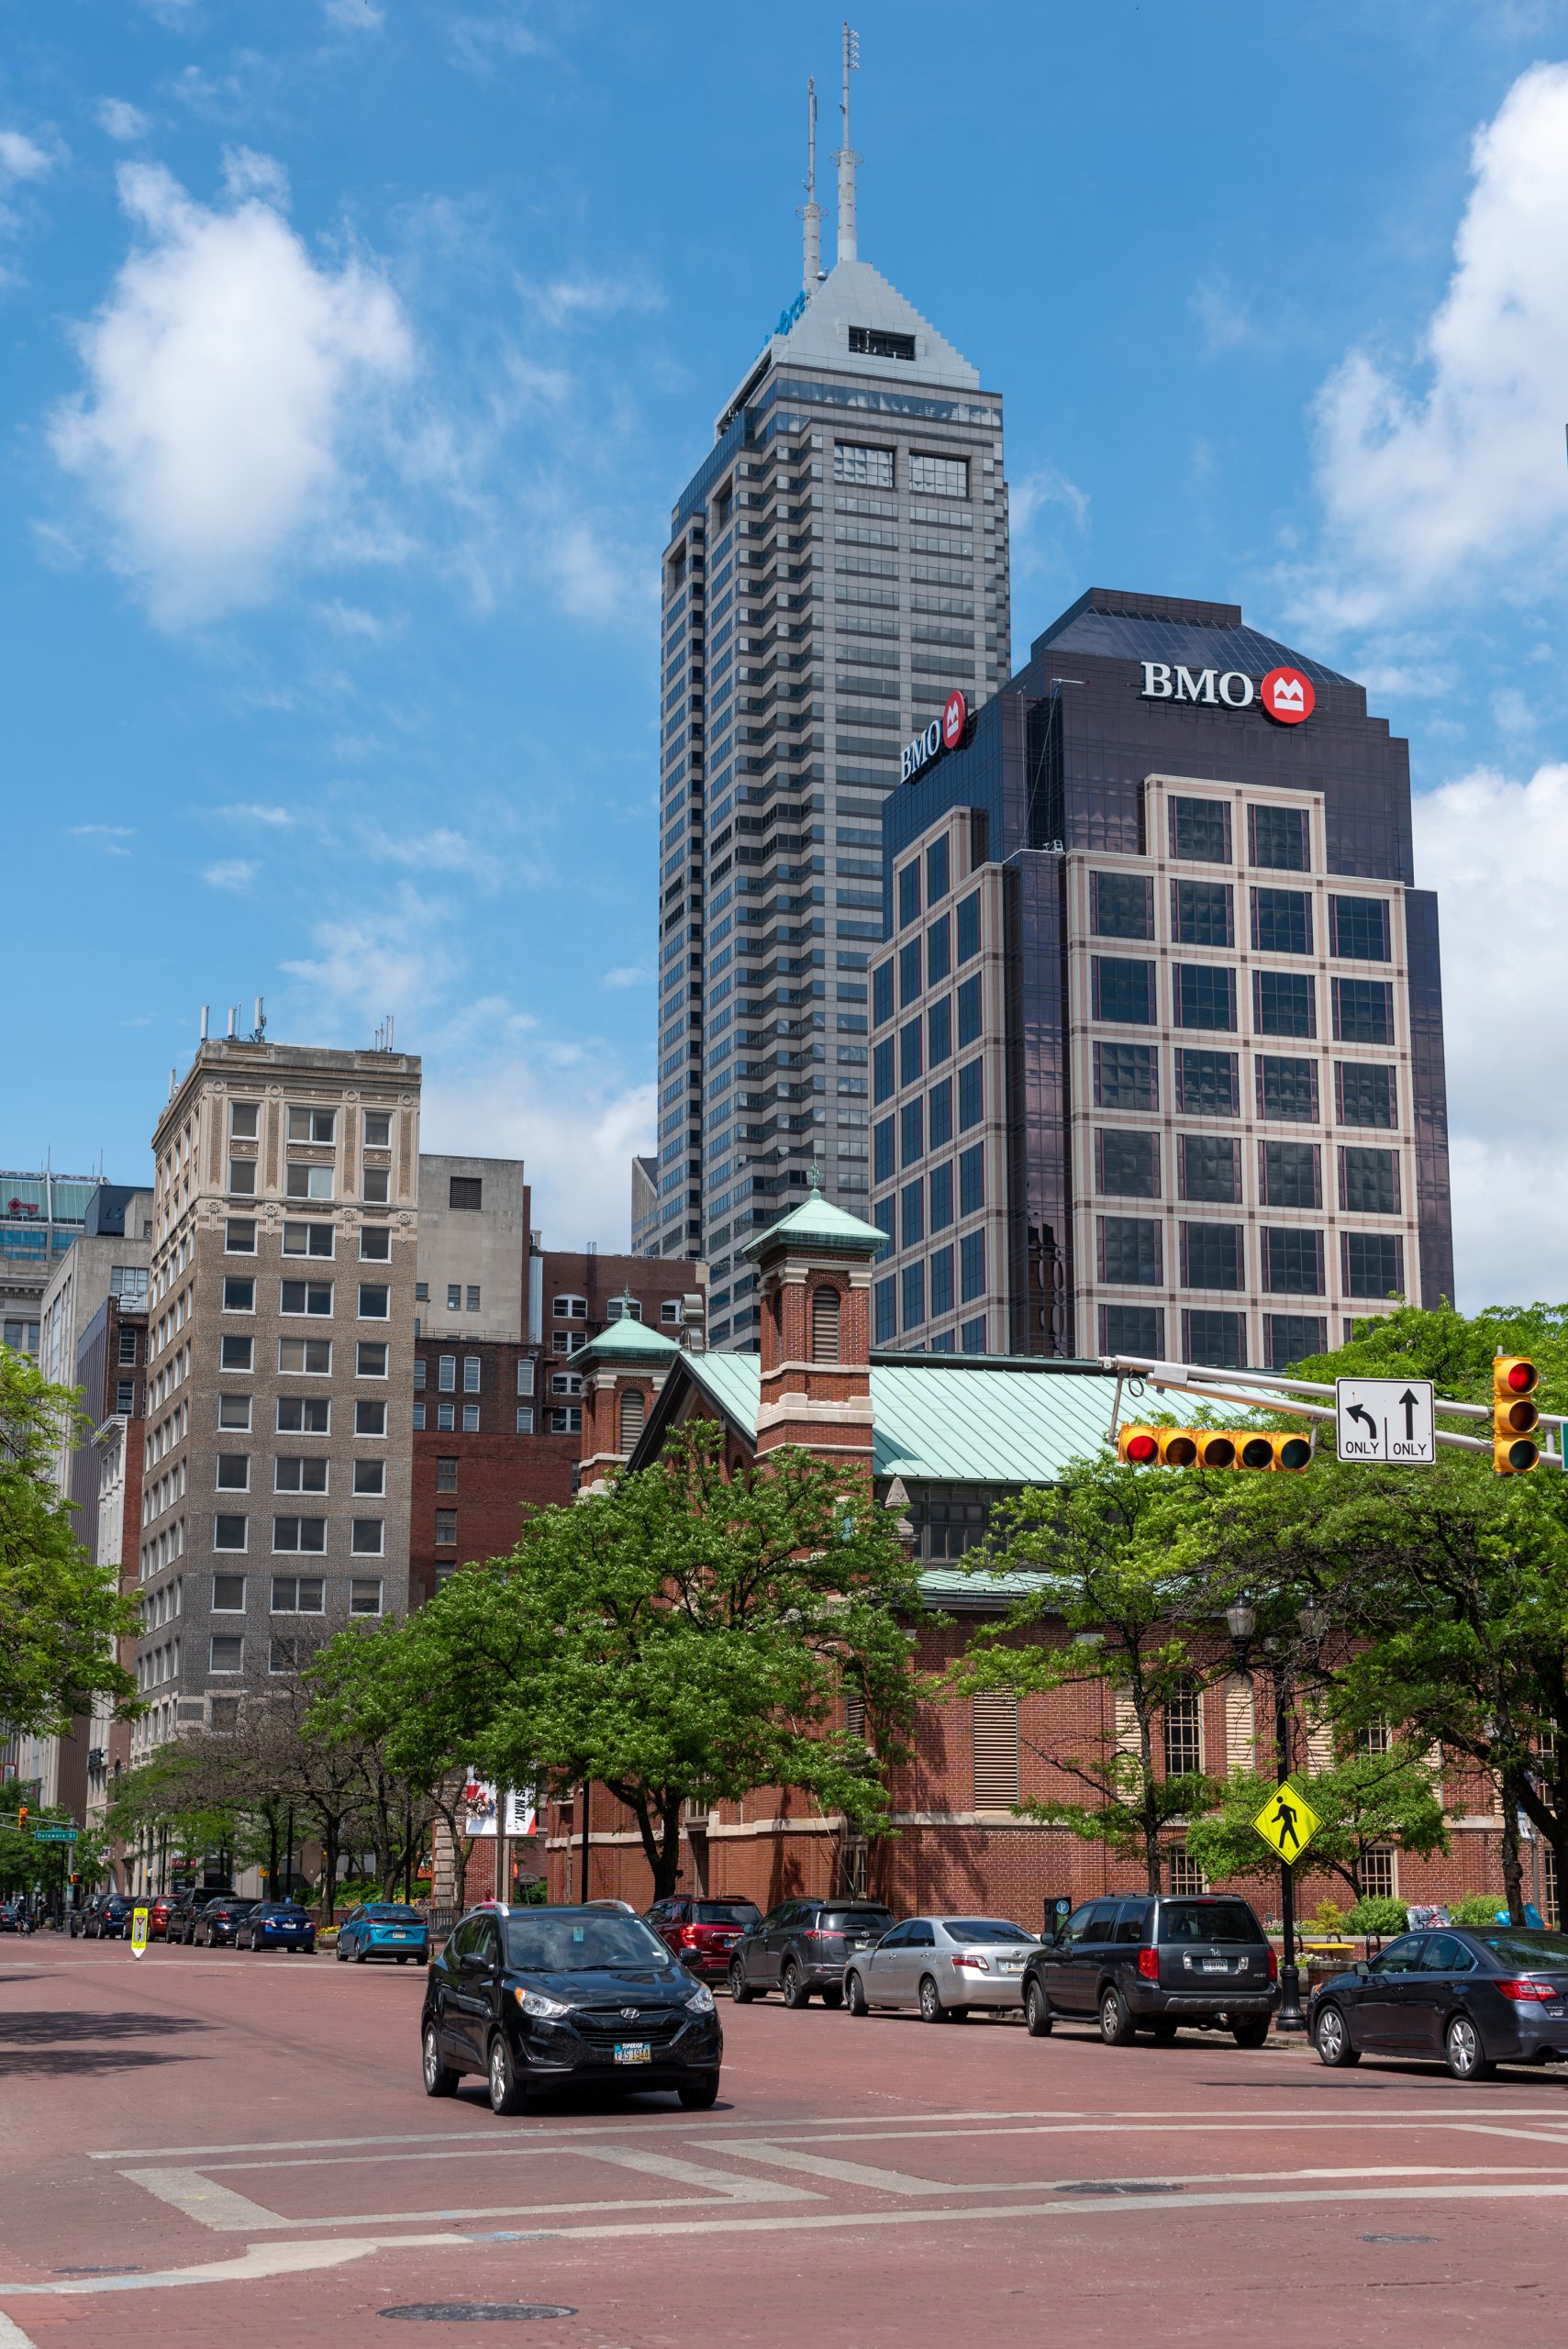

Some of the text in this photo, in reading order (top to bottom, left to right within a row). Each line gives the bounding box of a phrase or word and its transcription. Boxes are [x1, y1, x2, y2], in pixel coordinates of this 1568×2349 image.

[1140, 661, 1254, 707] BMO
[900, 719, 941, 784] BMO
[1345, 1441, 1379, 1454] ONLY
[1393, 1442, 1427, 1456] ONLY
